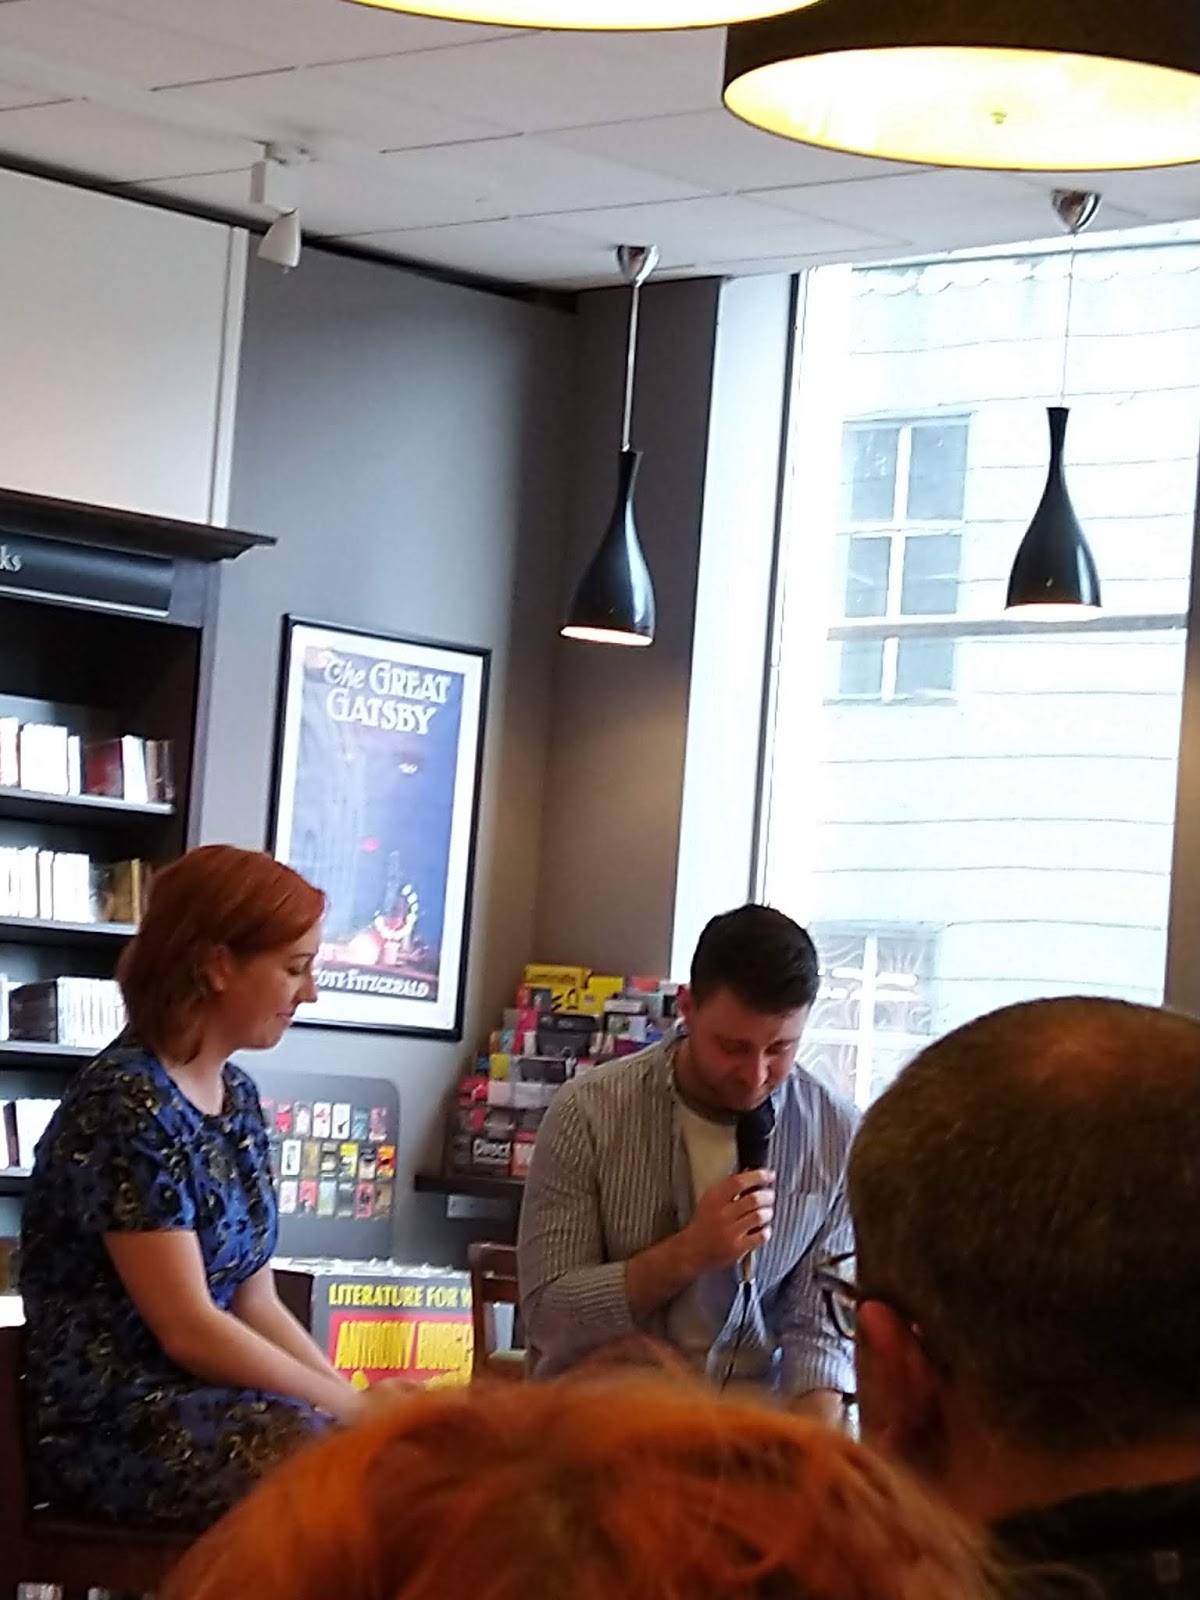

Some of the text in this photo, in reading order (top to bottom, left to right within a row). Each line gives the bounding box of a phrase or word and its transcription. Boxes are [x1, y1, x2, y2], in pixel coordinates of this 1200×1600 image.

[0, 544, 22, 572] ks
[321, 654, 452, 704] The GREAT
[326, 688, 437, 735] GATSBY
[328, 1283, 424, 1306] LITERATURE
[426, 1285, 458, 1308] FOR
